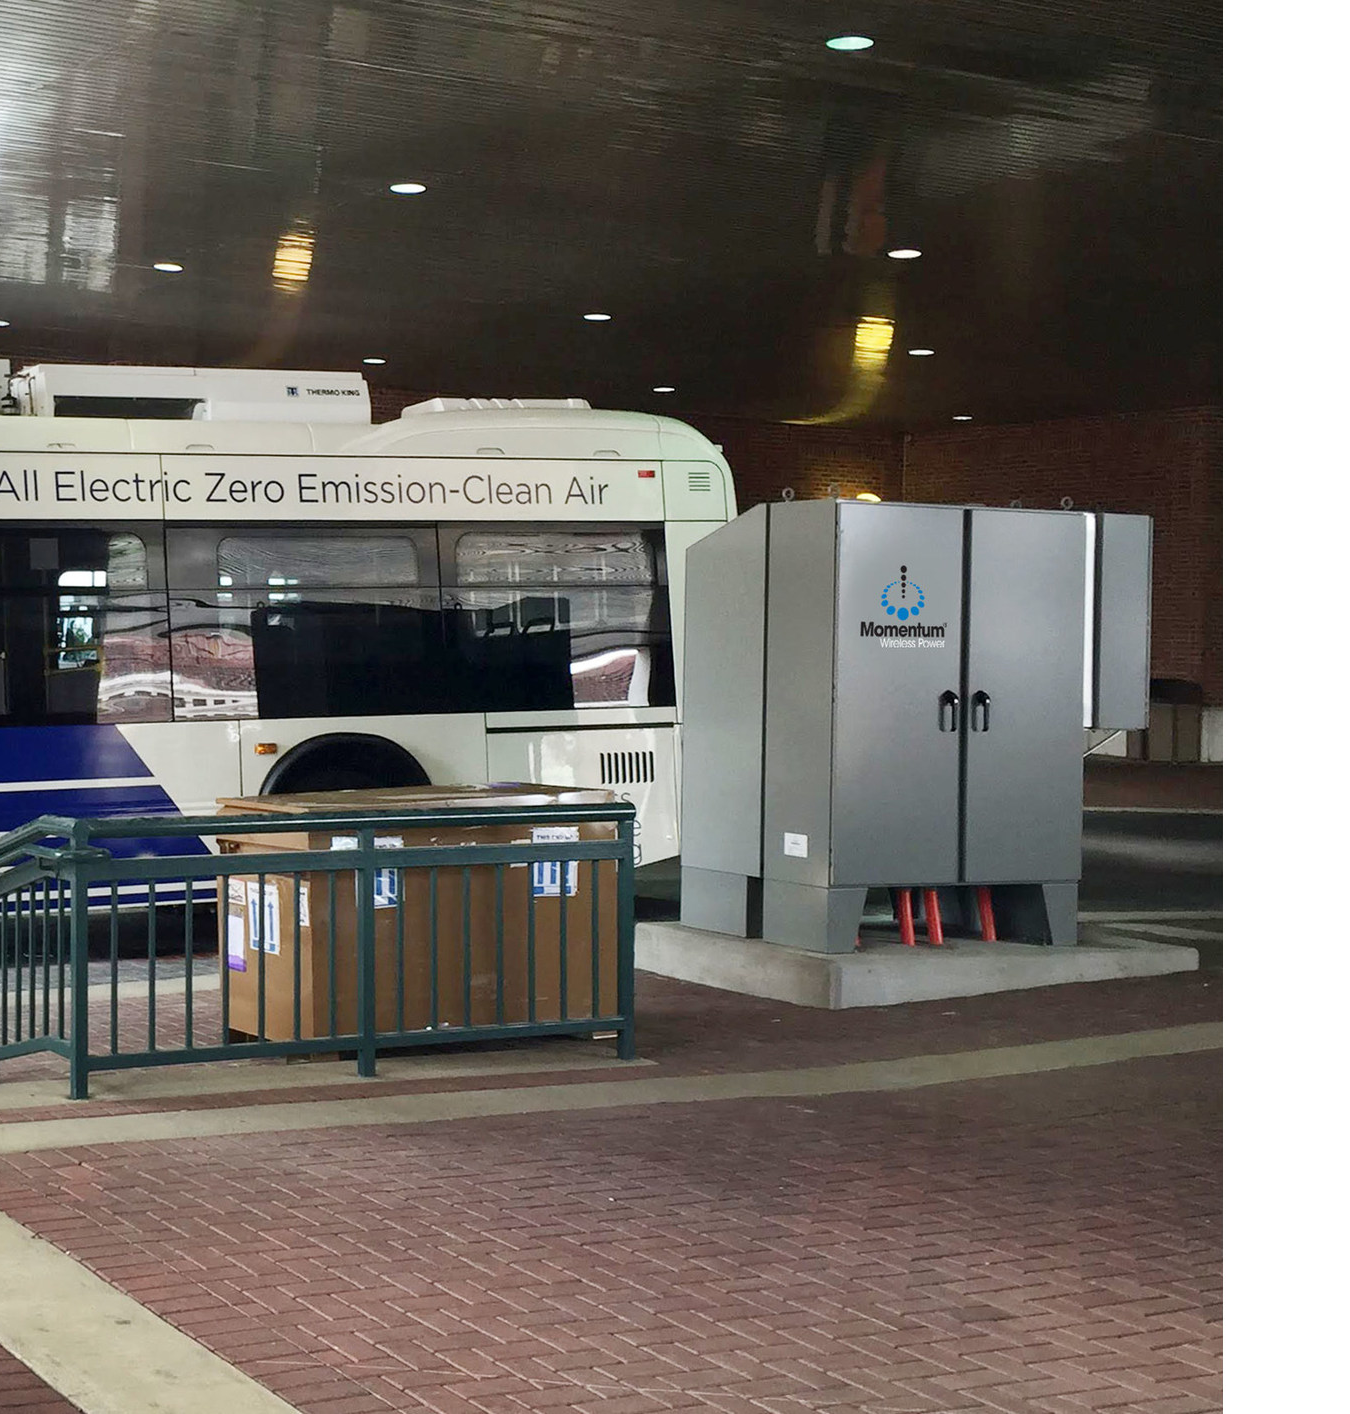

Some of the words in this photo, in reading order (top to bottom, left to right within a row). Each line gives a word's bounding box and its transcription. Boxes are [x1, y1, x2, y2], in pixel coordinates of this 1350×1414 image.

[306, 388, 340, 397] THERMO
[341, 389, 361, 397] KING
[54, 470, 192, 502] Electric
[204, 472, 285, 503] Zero
[297, 473, 553, 505] Emission-Clean
[564, 476, 609, 505] Air
[879, 638, 916, 649] Wireless
[917, 638, 946, 649] Power
